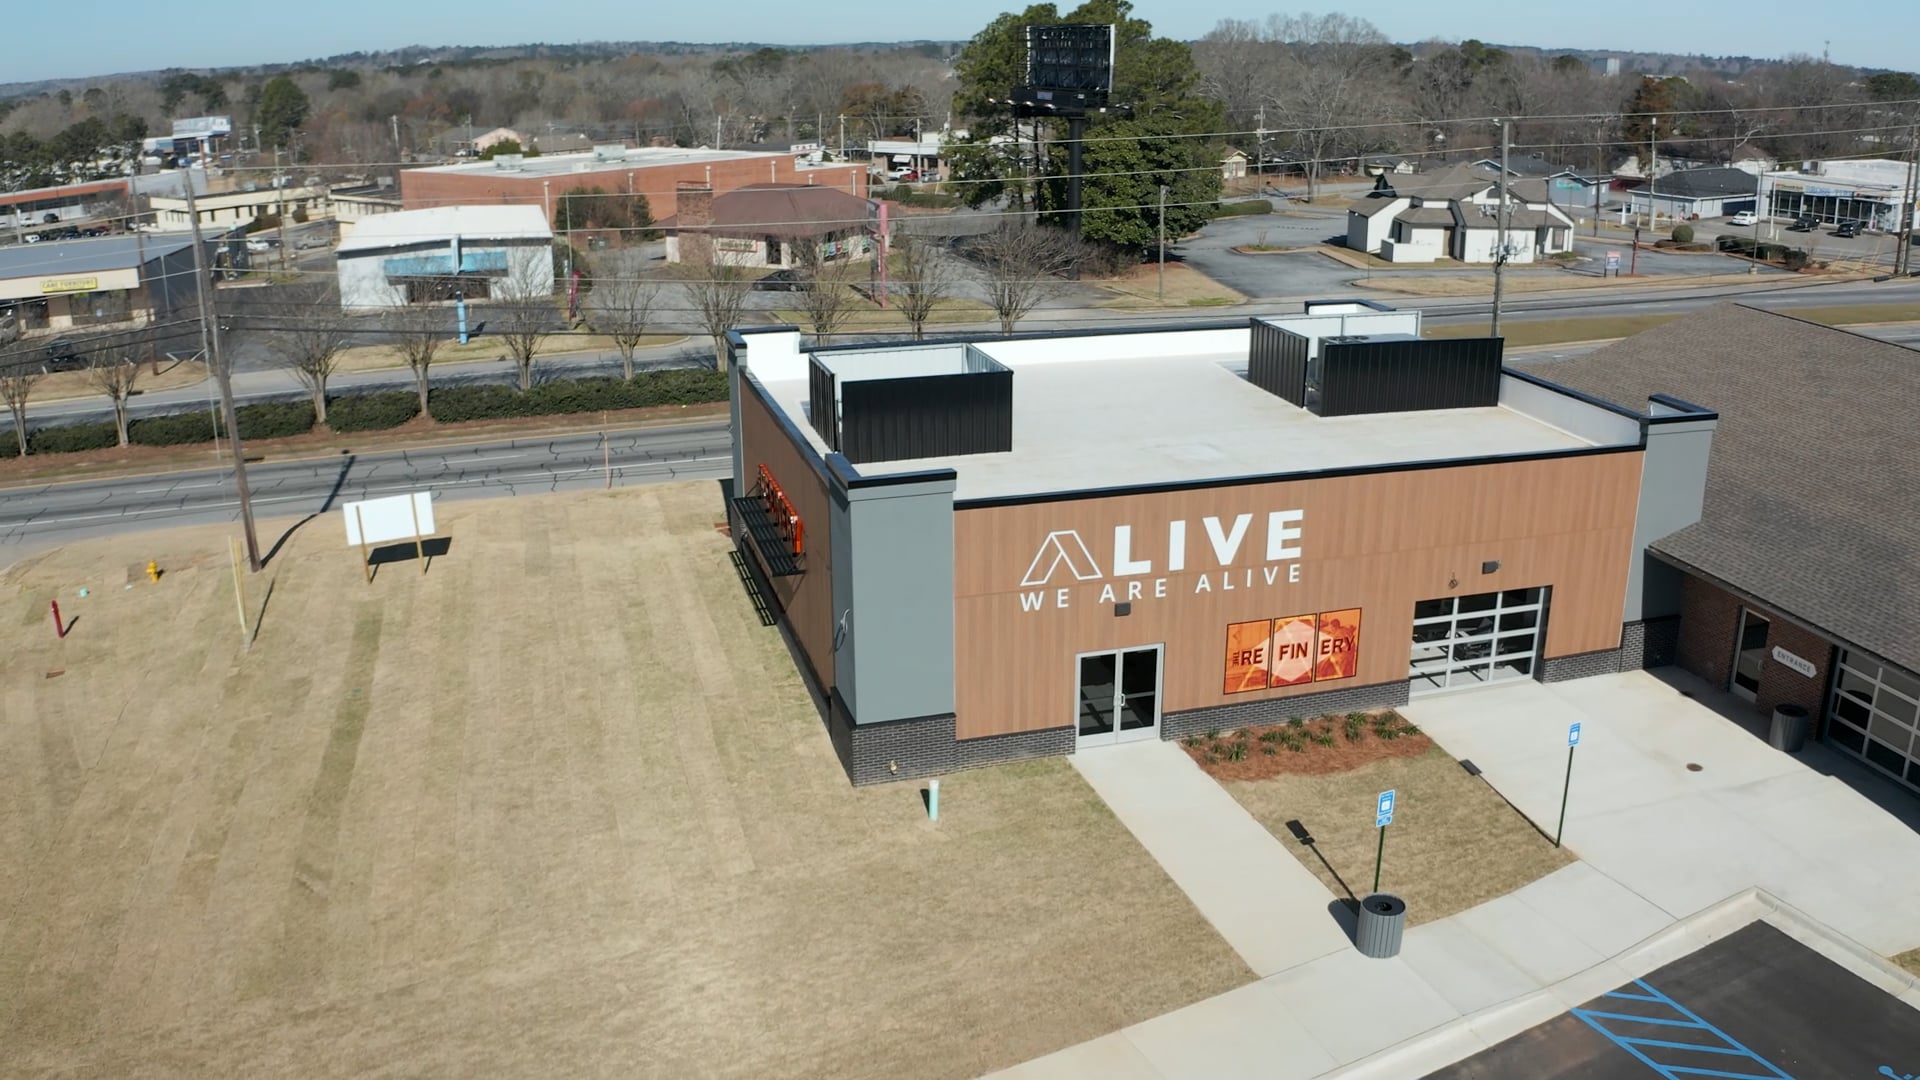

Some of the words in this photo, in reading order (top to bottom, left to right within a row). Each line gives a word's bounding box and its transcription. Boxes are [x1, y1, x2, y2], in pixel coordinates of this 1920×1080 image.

[1020, 588, 1069, 611] WE
[1099, 578, 1167, 603] ARE
[1195, 564, 1300, 593] ALIVE
[1777, 651, 1811, 673] ENTRANCE
